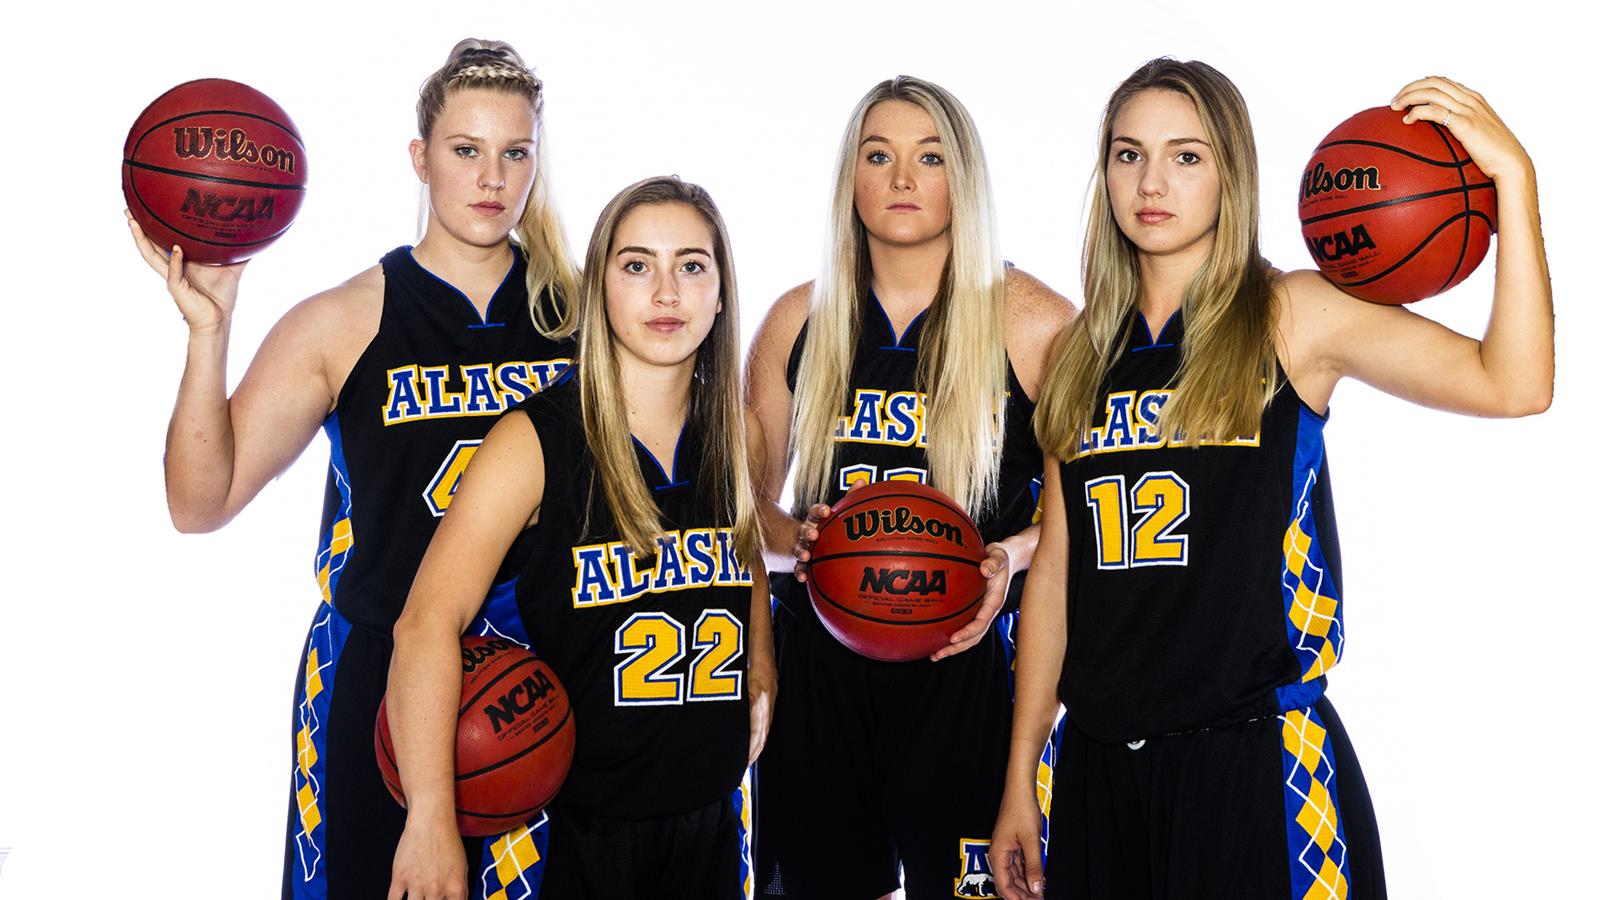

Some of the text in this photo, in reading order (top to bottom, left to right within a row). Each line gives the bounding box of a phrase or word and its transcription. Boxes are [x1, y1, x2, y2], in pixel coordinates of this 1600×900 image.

[172, 126, 296, 175] Wilson
[179, 187, 275, 222] NCAA
[1299, 161, 1381, 201] ilson
[382, 358, 573, 427] ALAS
[843, 507, 965, 547] Wilson
[1085, 471, 1190, 569] 12
[571, 527, 753, 609] ALASK
[859, 567, 947, 595] NCAA
[614, 609, 743, 706] 22
[483, 669, 556, 733] NCAA
